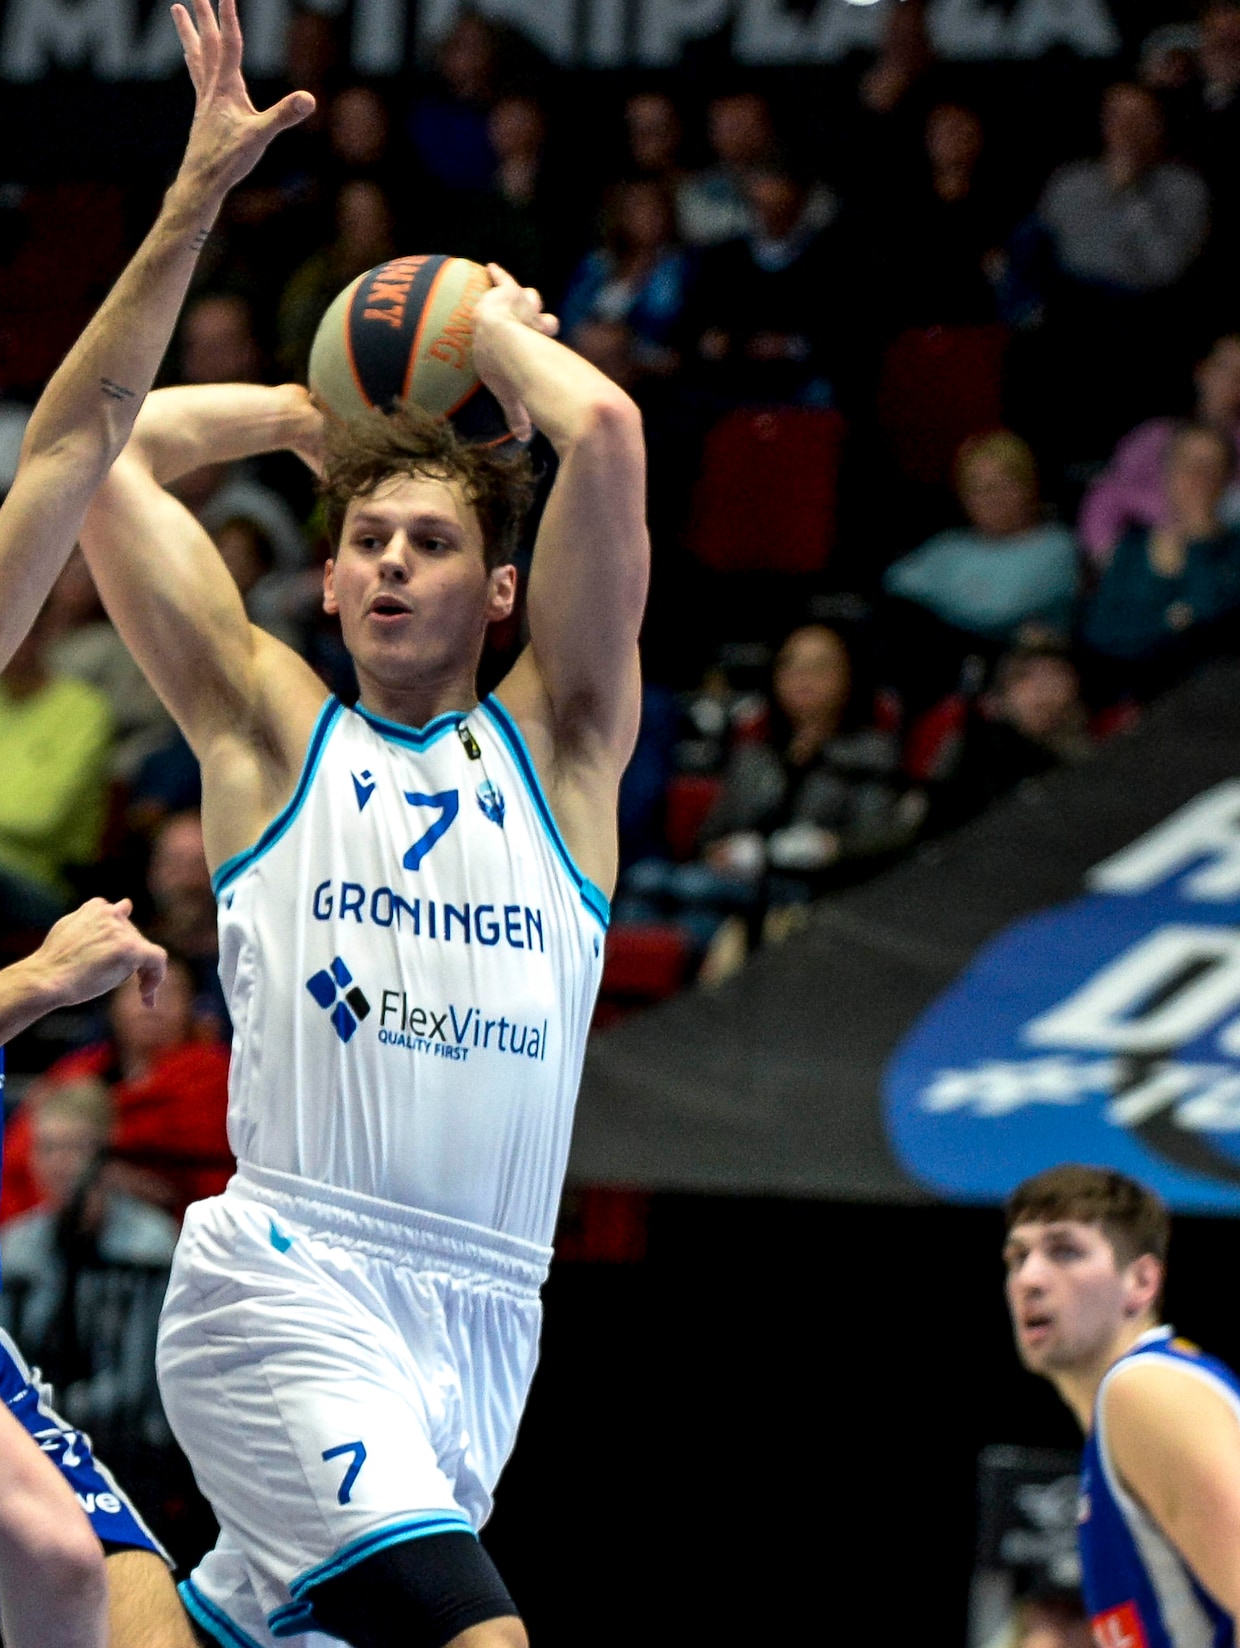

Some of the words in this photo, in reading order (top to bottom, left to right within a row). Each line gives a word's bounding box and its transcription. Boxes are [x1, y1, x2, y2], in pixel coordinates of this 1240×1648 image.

[403, 789, 459, 871] 7
[313, 880, 544, 953] GRONINGEN
[377, 1029, 431, 1056] QUALITY
[434, 1043, 468, 1061] FIRST
[379, 989, 548, 1061] FlexVirtual
[322, 1441, 367, 1505] 7
